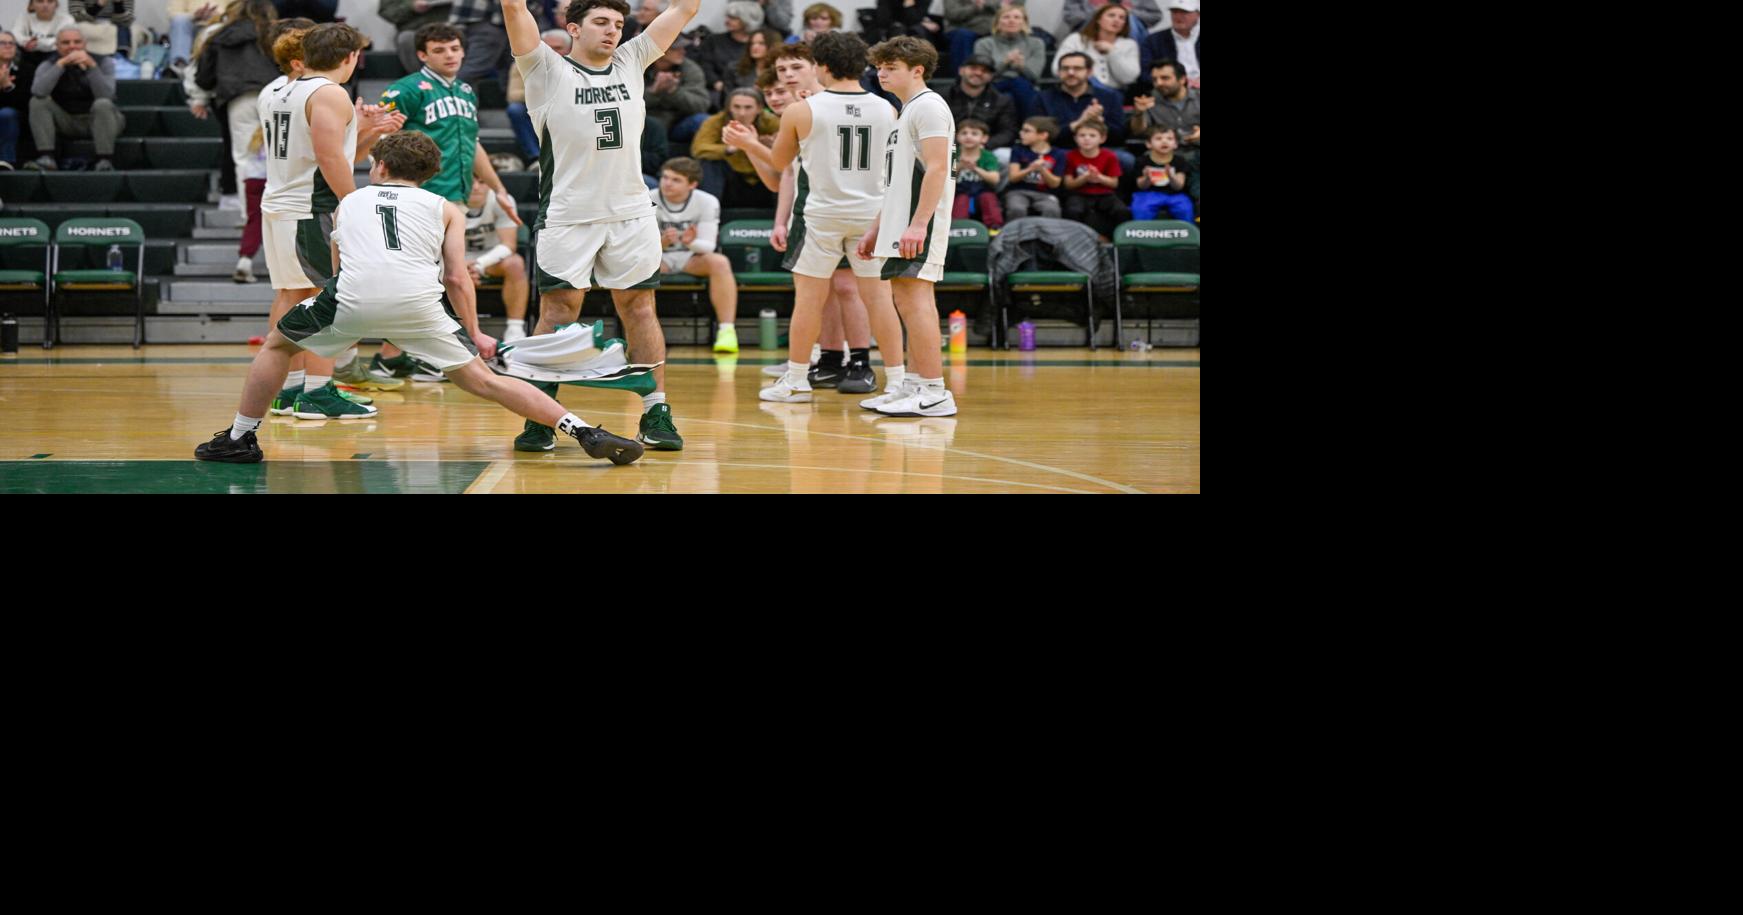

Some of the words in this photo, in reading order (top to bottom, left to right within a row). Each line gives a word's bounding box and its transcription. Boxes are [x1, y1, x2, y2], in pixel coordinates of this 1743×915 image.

[575, 83, 631, 104] HORNETS
[594, 107, 623, 150] 3
[837, 125, 871, 170] 11
[68, 227, 131, 236] HORNETS
[376, 204, 402, 250] 1
[1126, 229, 1189, 238] HORNETS
